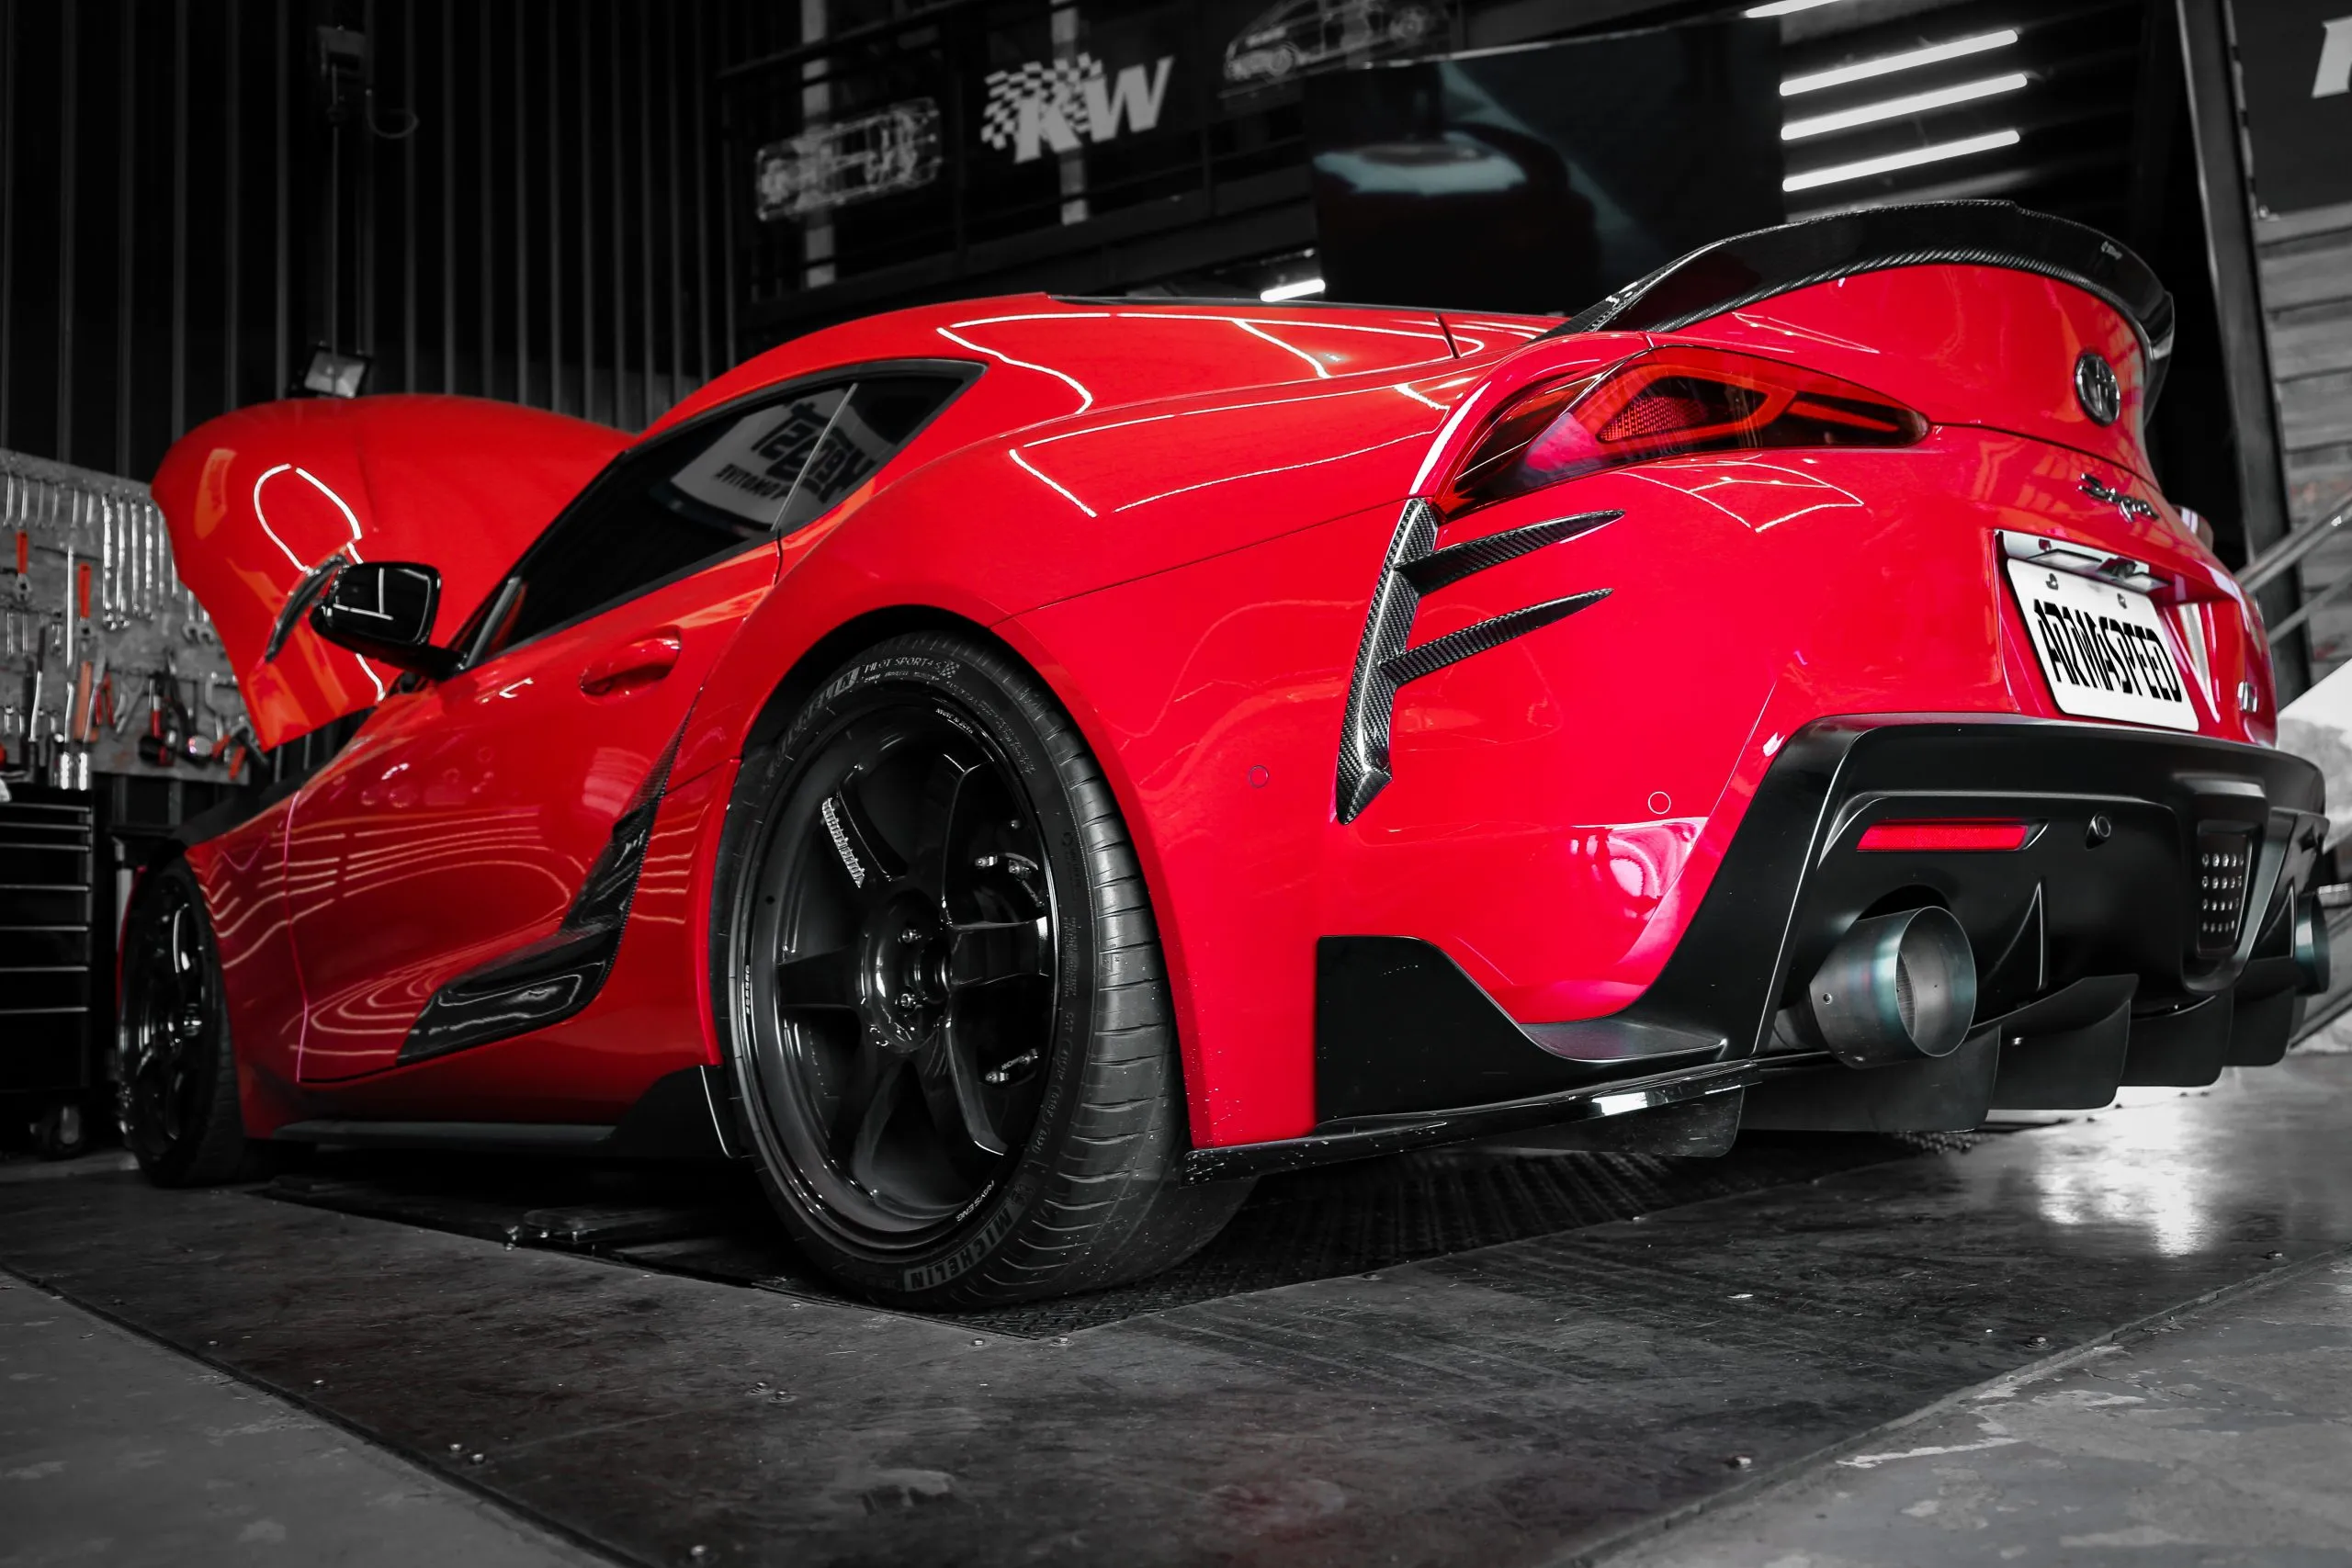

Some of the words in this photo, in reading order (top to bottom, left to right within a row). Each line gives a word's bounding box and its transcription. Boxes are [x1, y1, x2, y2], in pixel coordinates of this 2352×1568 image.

[1012, 55, 1175, 164] KW
[864, 657, 893, 674] PILOT
[895, 656, 928, 667] SPORT
[2032, 598, 2183, 703] ARMASPEED
[910, 1207, 1013, 1290] MICHELIN
